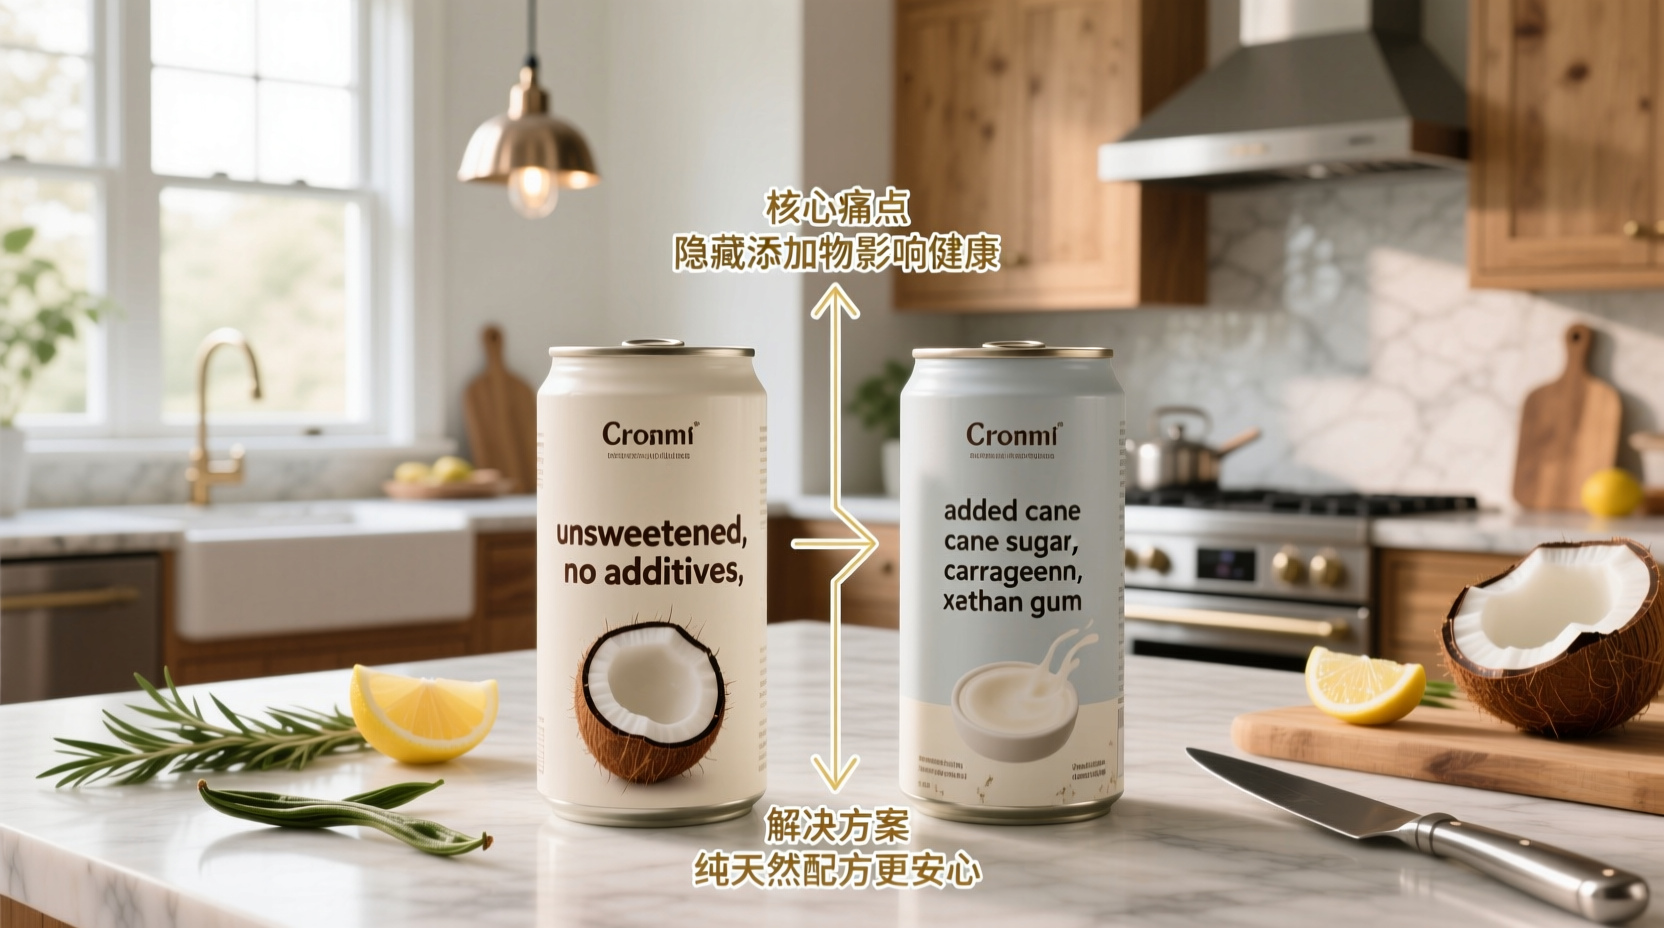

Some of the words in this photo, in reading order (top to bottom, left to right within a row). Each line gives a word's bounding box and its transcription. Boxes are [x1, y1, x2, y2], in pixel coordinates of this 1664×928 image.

[944, 497, 1017, 522] added
[1025, 504, 1081, 522] cane
[556, 513, 748, 549] unsweetened,
[944, 533, 999, 551] cane
[1006, 534, 1079, 559] sugar,
[564, 562, 597, 584] no
[604, 555, 744, 588] additives,
[943, 563, 1083, 589] carrageenn,
[1030, 593, 1082, 619] gum
